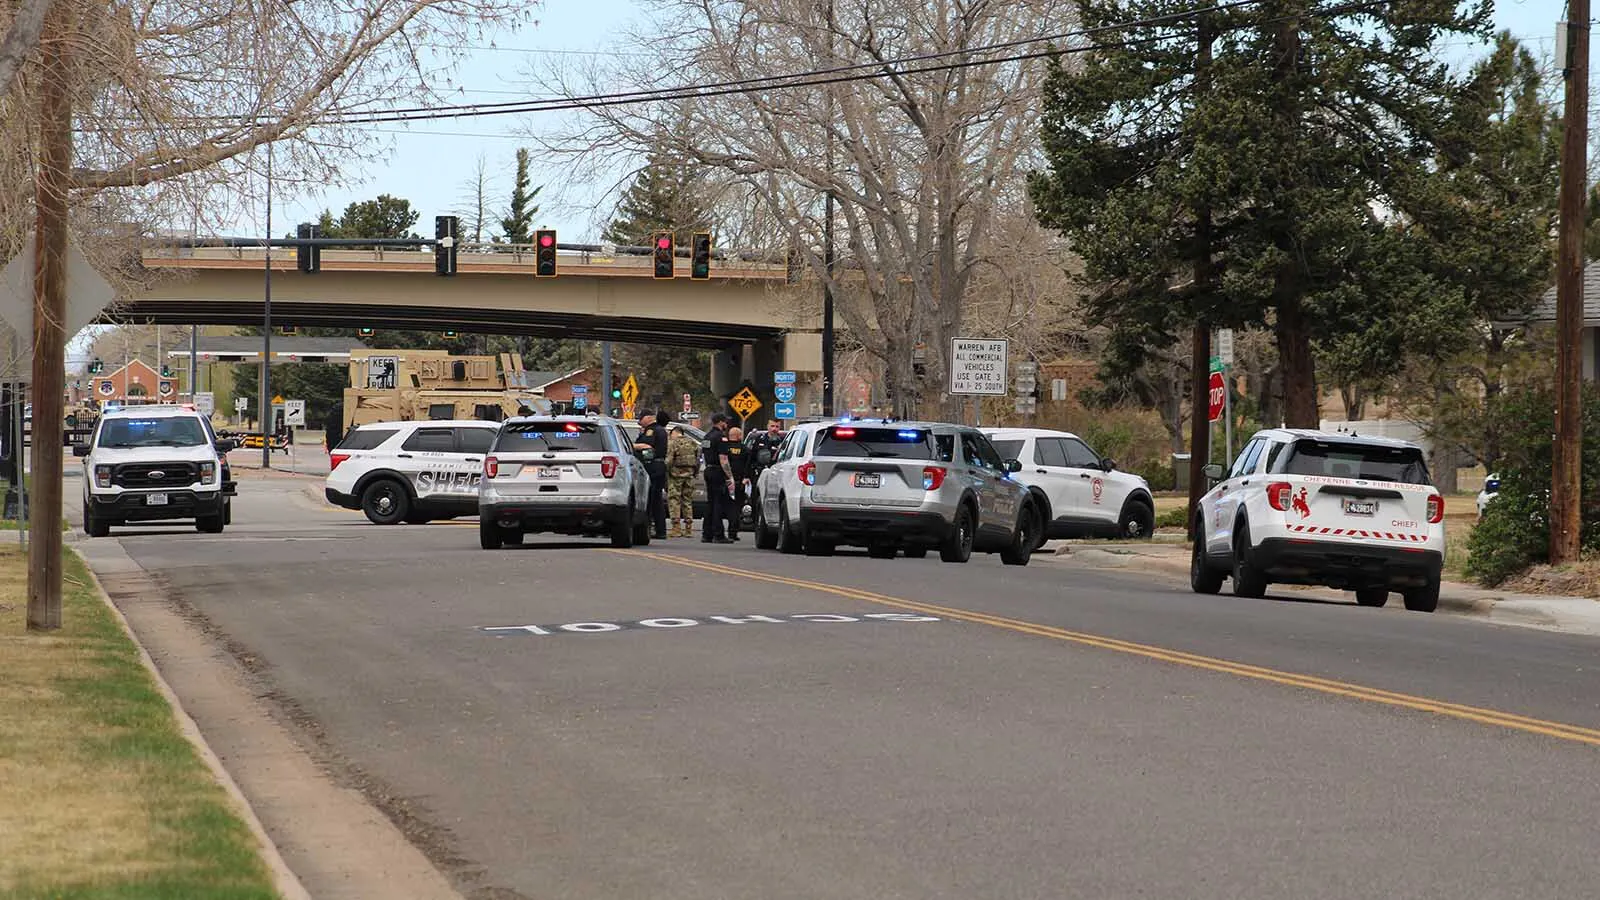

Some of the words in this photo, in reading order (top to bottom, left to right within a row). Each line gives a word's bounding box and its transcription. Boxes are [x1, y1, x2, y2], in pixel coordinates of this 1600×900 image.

[964, 363, 994, 371] VEHICLES
[996, 373, 1001, 381] 3
[778, 388, 793, 398] 25
[1209, 387, 1224, 406] TOP
[1303, 476, 1351, 484] CHEYENNE
[1394, 483, 1425, 491] RESCUE
[484, 612, 941, 635] SCHOOL
